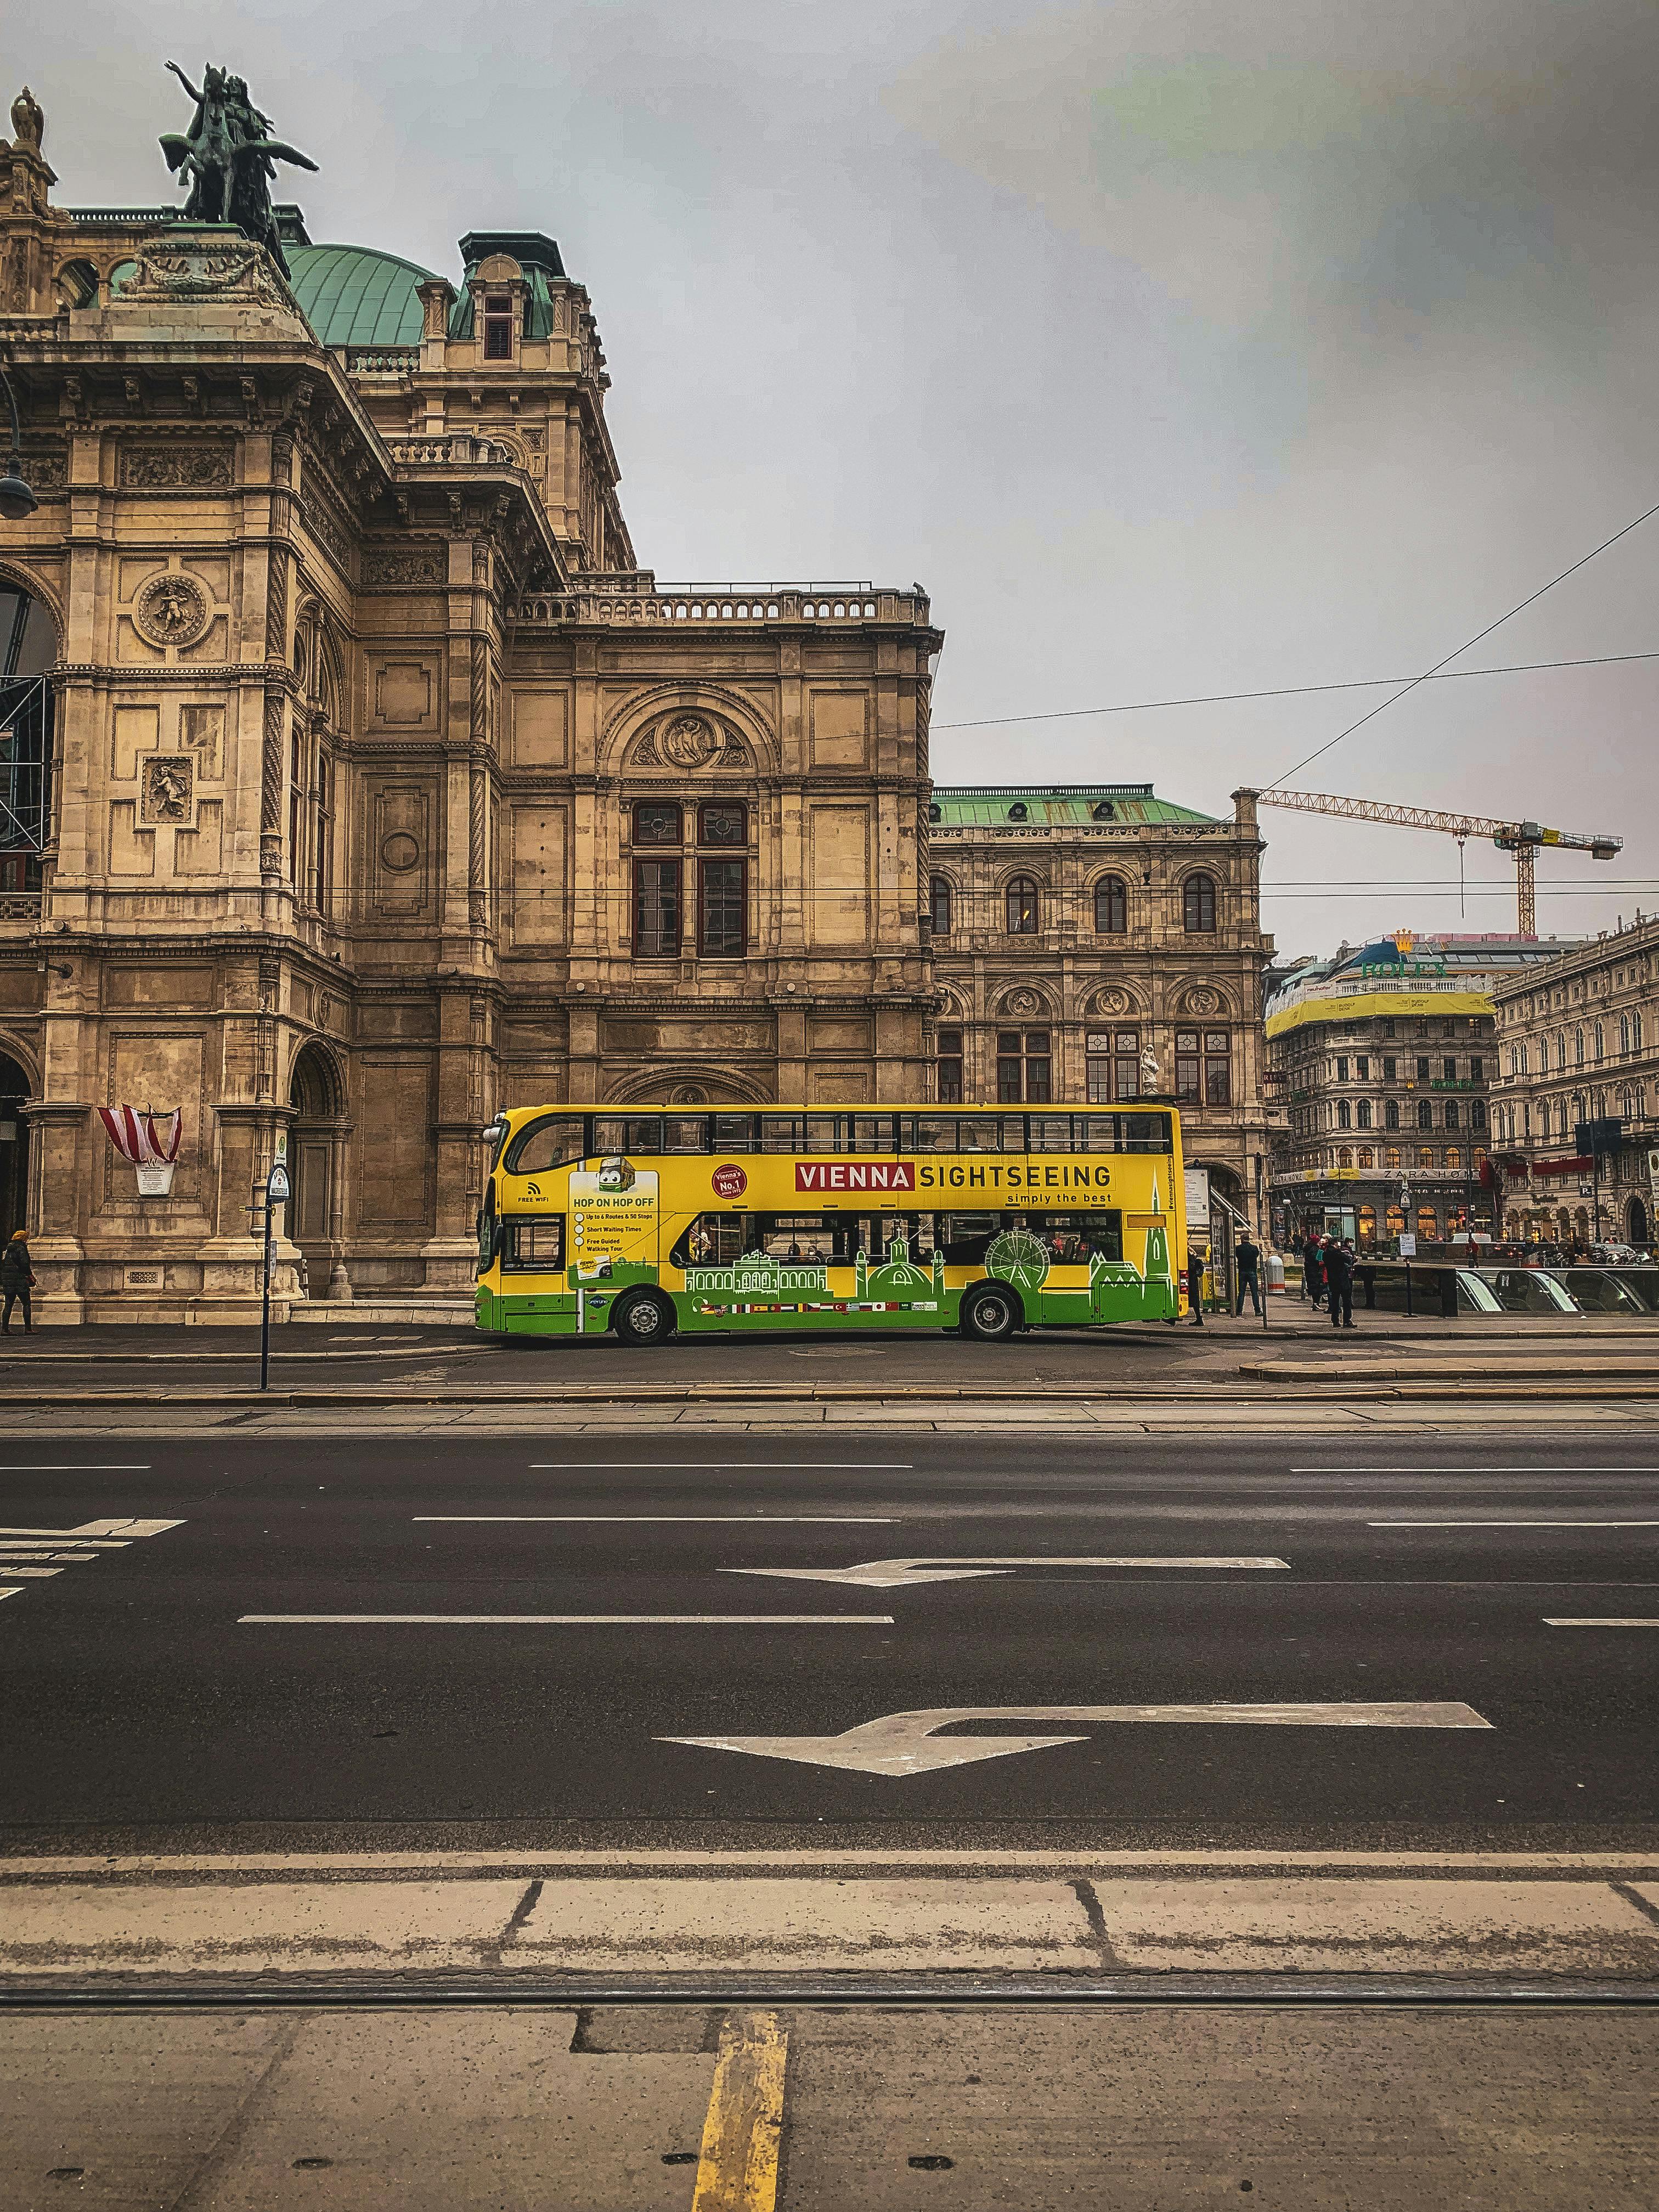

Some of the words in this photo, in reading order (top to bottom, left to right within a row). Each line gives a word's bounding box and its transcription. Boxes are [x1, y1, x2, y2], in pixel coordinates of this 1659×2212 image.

[1362, 962, 1448, 978] ROLEX
[715, 1171, 741, 1180] Vienna's
[799, 1166, 910, 1187] VIENNA
[919, 1166, 1111, 1187] SIGHTSEEING
[1384, 1170, 1429, 1178] ZARA
[720, 1180, 740, 1191] No.1
[574, 1199, 594, 1207] HOP
[596, 1199, 610, 1207] ON
[613, 1198, 633, 1206] HOP
[635, 1198, 654, 1206] OFF
[1007, 1194, 1051, 1204] simply
[1057, 1194, 1077, 1203] the
[1084, 1194, 1111, 1203] best
